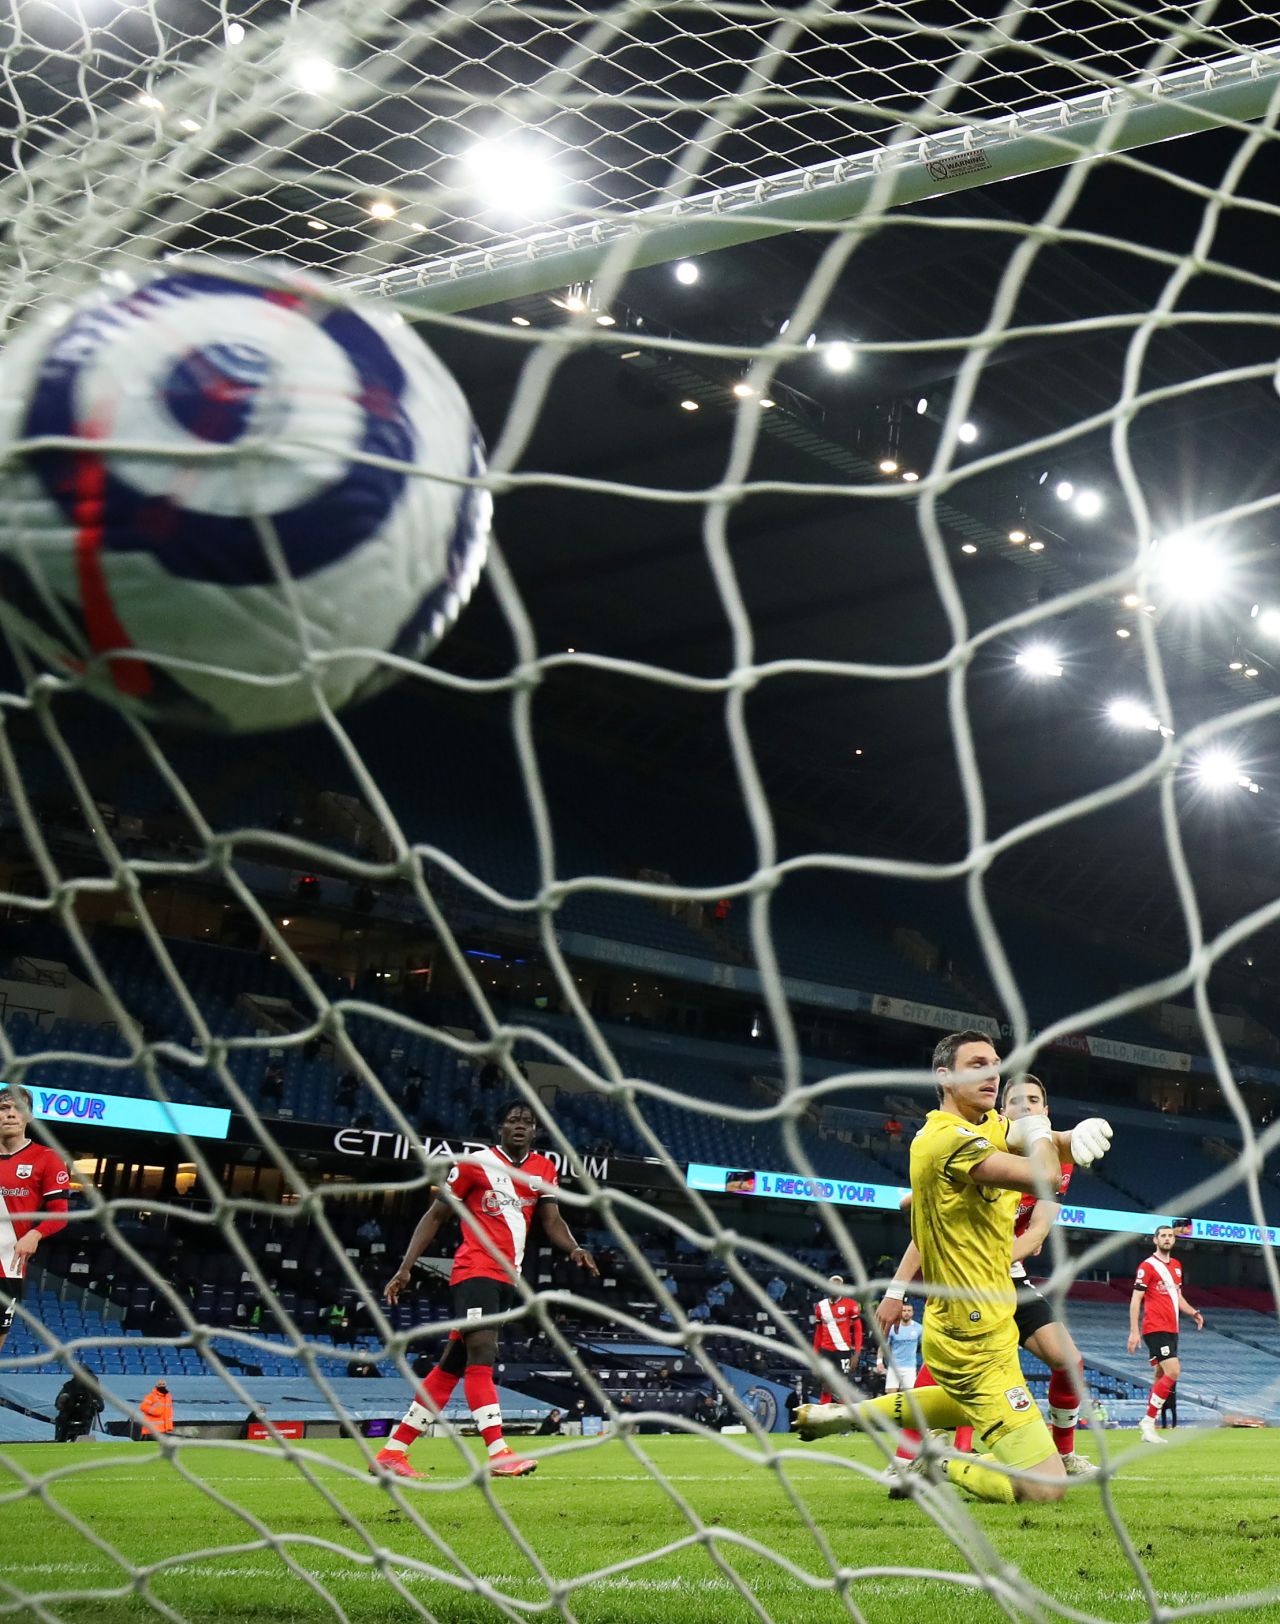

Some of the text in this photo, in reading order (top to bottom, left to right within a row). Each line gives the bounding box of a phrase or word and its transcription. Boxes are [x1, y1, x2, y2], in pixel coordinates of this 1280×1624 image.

[946, 156, 985, 170] WARNING
[903, 1004, 930, 1020] CITY
[39, 1092, 106, 1120] YOUR
[762, 1176, 771, 1191] 1.
[837, 1185, 876, 1202] YOUR
[1206, 1224, 1247, 1240] RECORD
